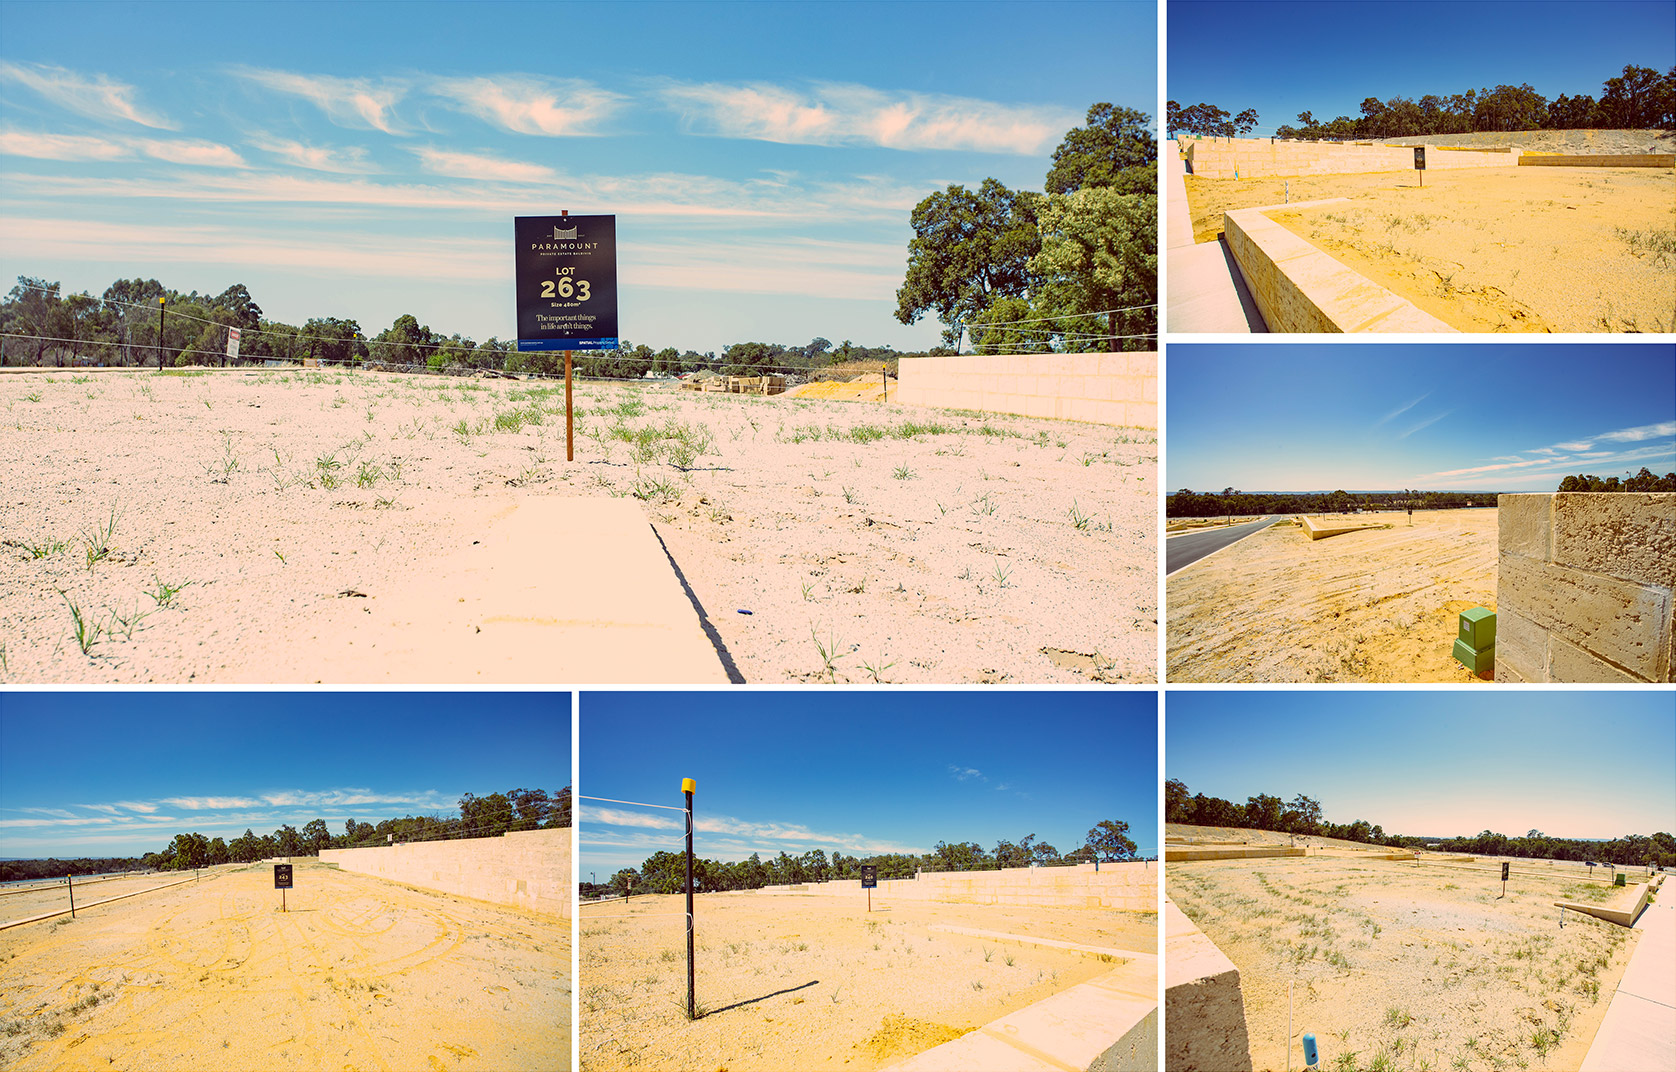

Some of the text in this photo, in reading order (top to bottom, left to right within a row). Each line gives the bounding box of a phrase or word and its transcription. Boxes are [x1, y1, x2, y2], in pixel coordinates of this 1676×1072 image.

[532, 242, 598, 250] PARAMOUNT
[556, 267, 576, 276] LOT
[540, 276, 591, 302] 263
[573, 322, 592, 330] things.
